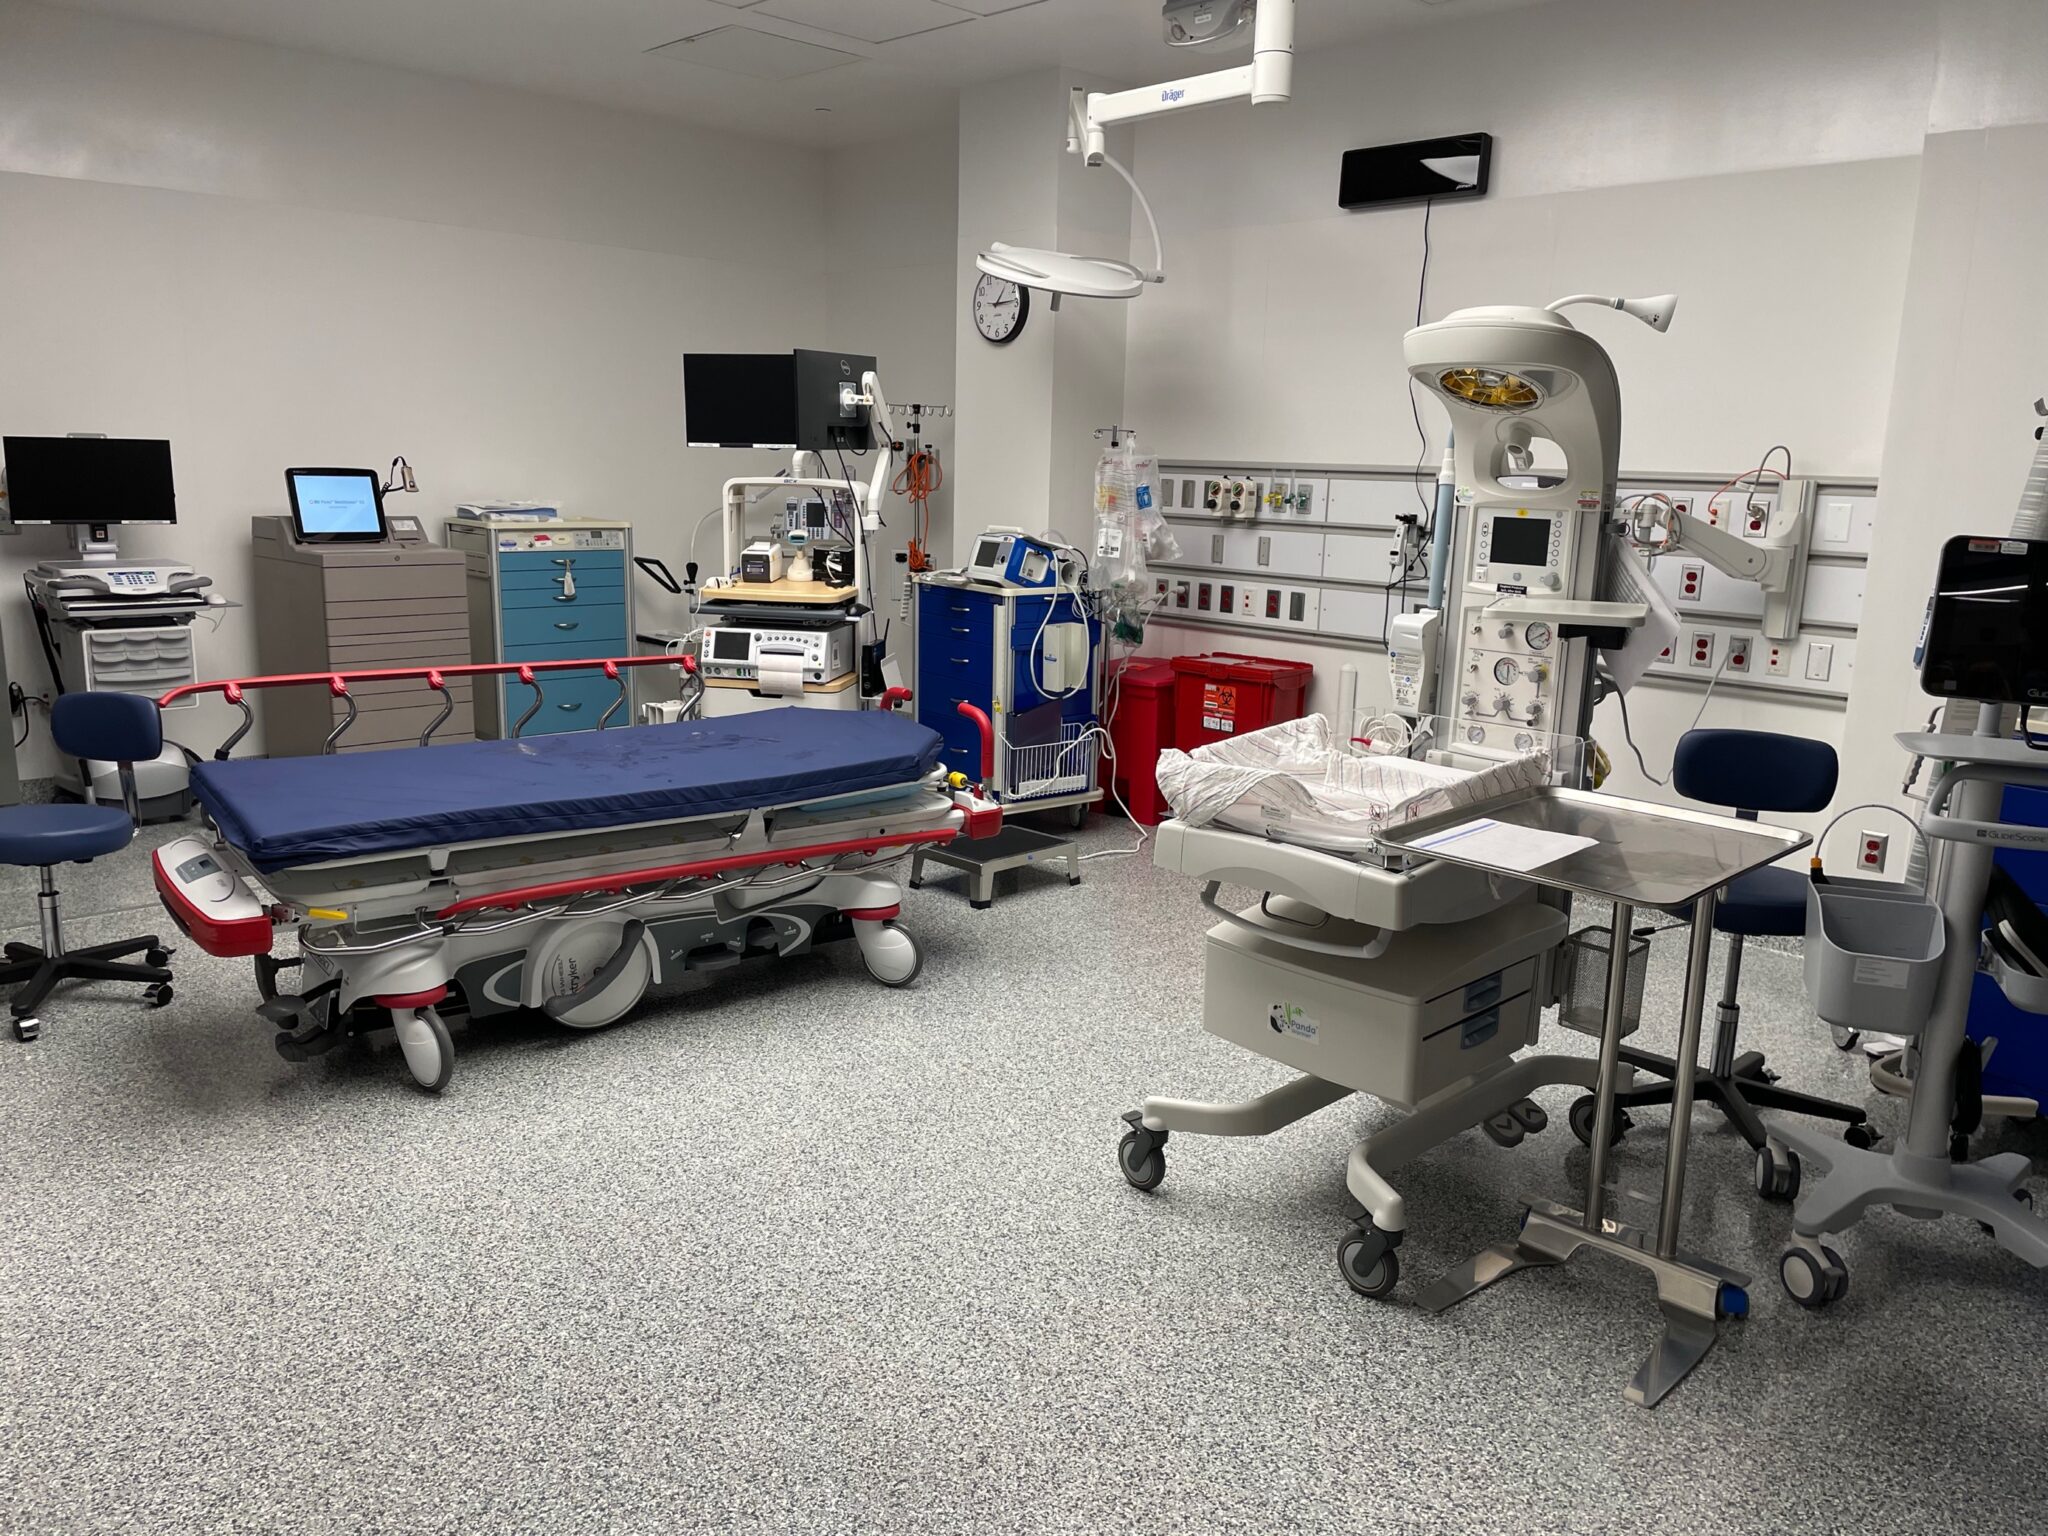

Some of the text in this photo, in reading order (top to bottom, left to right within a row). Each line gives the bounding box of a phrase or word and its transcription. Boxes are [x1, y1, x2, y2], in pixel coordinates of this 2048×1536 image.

[1161, 89, 1185, 101] Dräger
[979, 286, 985, 297] 10
[1011, 283, 1016, 293] 2
[977, 301, 982, 311] 9
[1014, 298, 1019, 307] 3
[979, 314, 984, 324] 8
[1011, 312, 1016, 321] 4
[986, 325, 991, 335] 7
[995, 328, 999, 337] 6
[1004, 323, 1009, 333] 5
[568, 958, 579, 993] tryker
[1291, 1020, 1316, 1034] Panda
